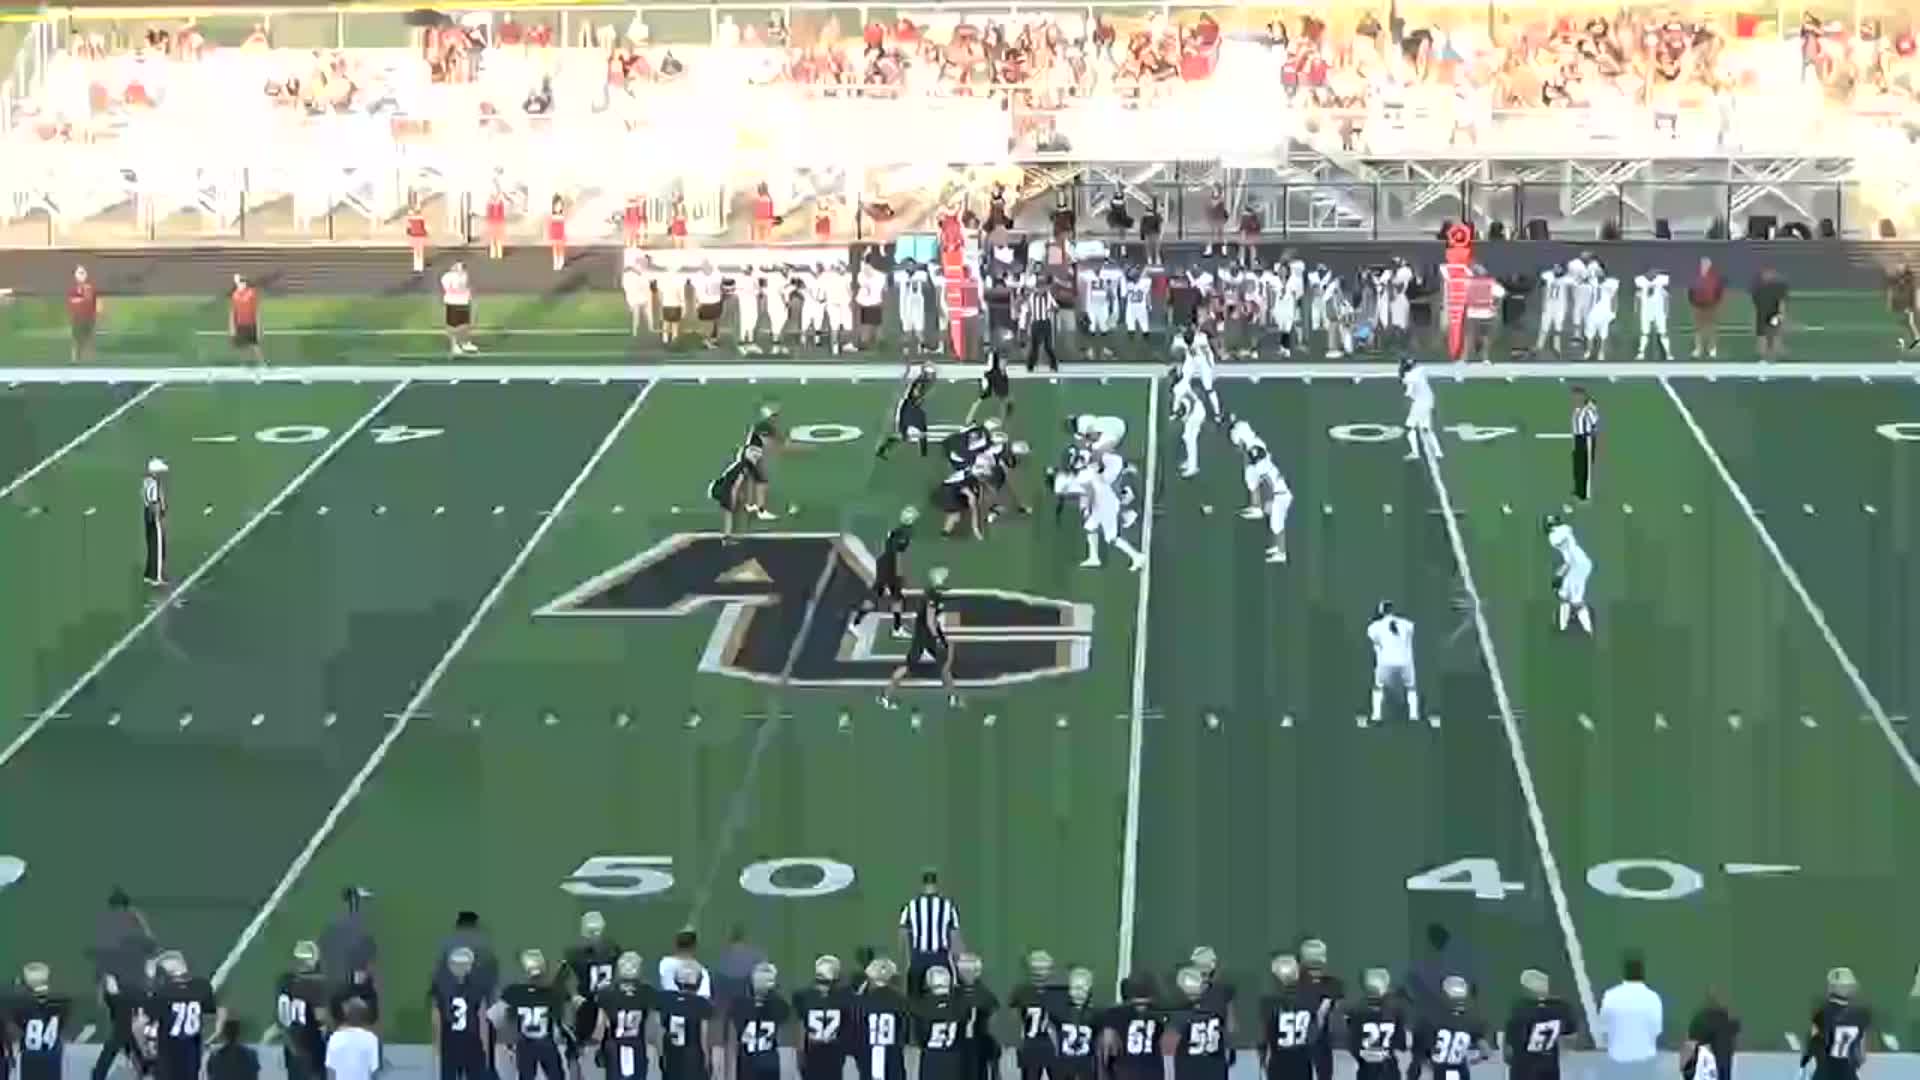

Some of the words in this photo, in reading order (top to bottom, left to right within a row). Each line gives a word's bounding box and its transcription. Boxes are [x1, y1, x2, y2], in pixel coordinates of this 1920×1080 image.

[559, 856, 854, 897] 50
[1406, 858, 1704, 899] 40
[169, 1001, 201, 1037] 78
[451, 997, 468, 1032] 3
[669, 1015, 686, 1046] 5
[807, 1009, 841, 1042] 52
[25, 1015, 60, 1051] 84
[741, 1020, 776, 1052] 42
[1060, 1023, 1093, 1056] 23
[1361, 1022, 1395, 1050] 27
